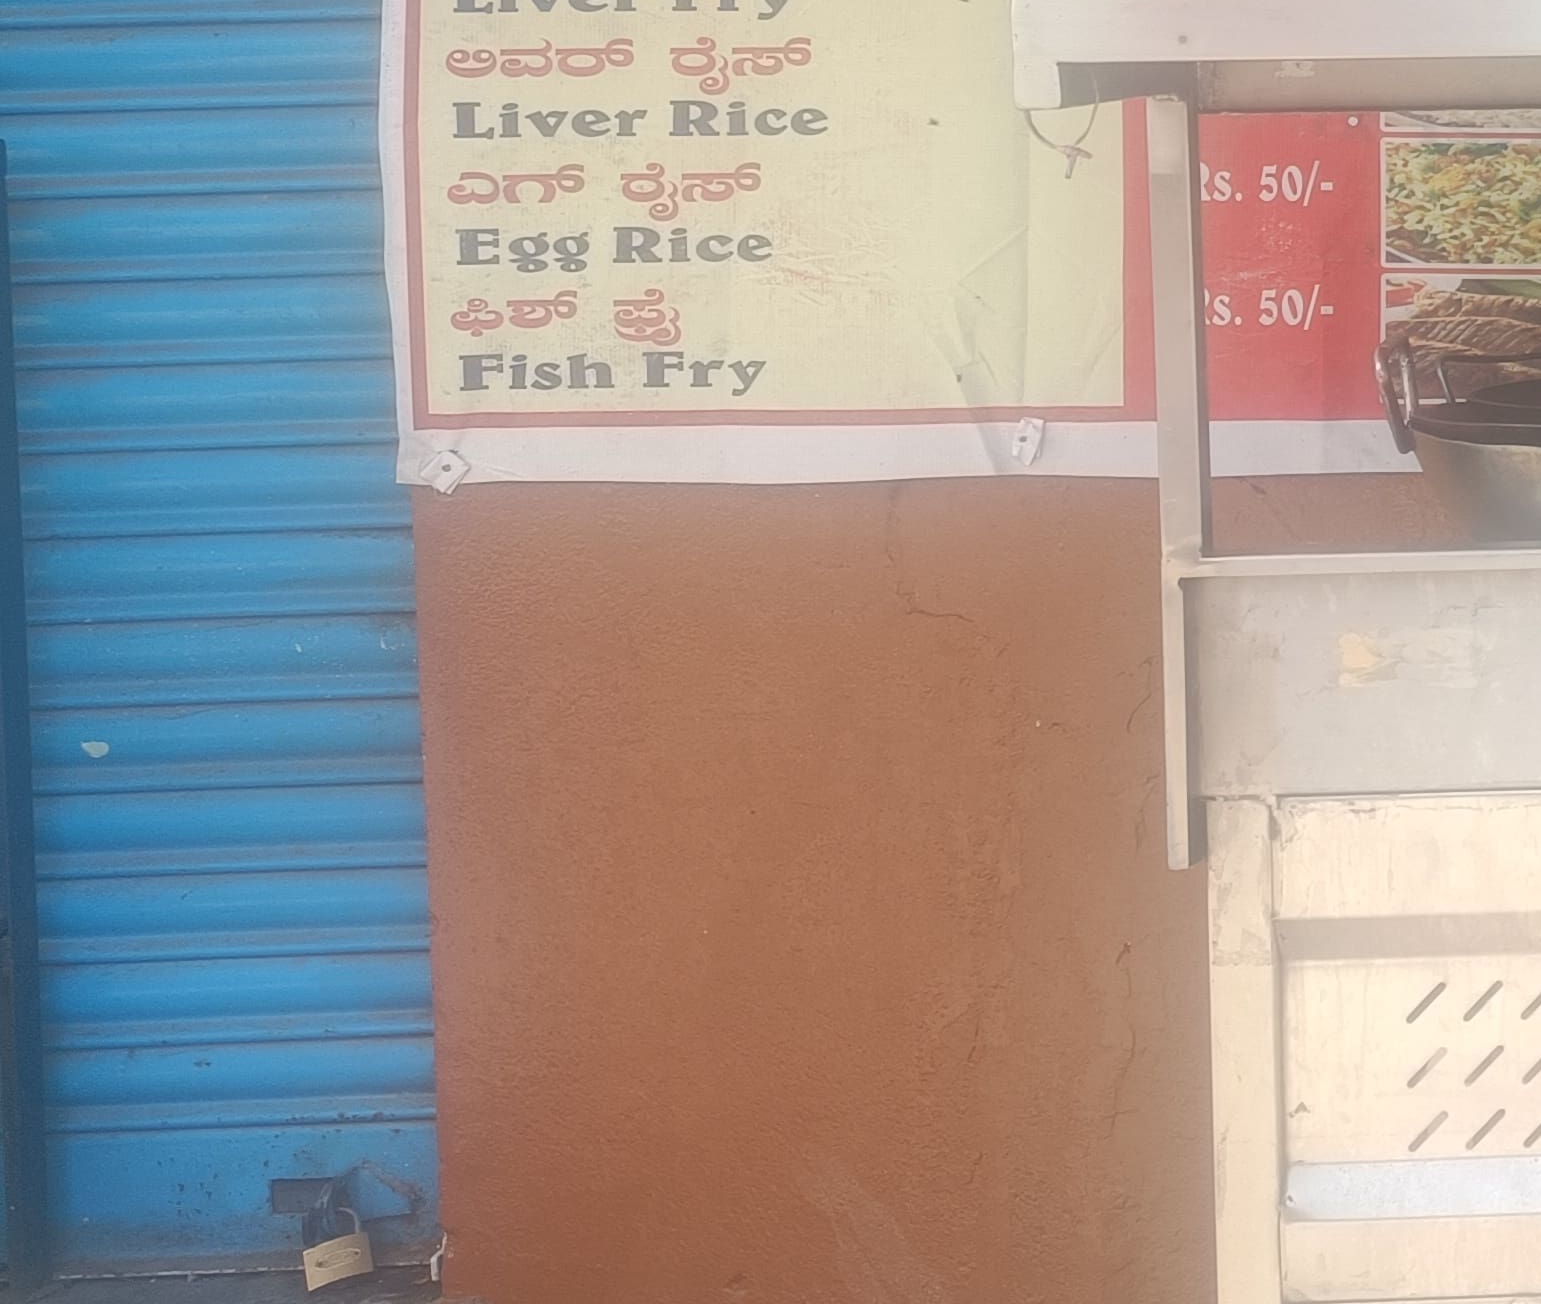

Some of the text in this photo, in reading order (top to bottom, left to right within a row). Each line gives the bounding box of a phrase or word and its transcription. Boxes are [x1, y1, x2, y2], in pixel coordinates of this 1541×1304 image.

[445, 36, 812, 96] ಲಿವರ್ ರೈಸ್
[452, 100, 829, 140] Liver Rice
[447, 162, 762, 222] ಎಗ್ ರೈಸ್
[1258, 160, 1335, 207] 50/-
[455, 226, 774, 274] Egg Rice
[450, 288, 682, 347] ಫಿಶ್ ಫ್ರೈ
[1202, 284, 1335, 331] s. 50/-
[459, 351, 767, 397] Fish Fry
